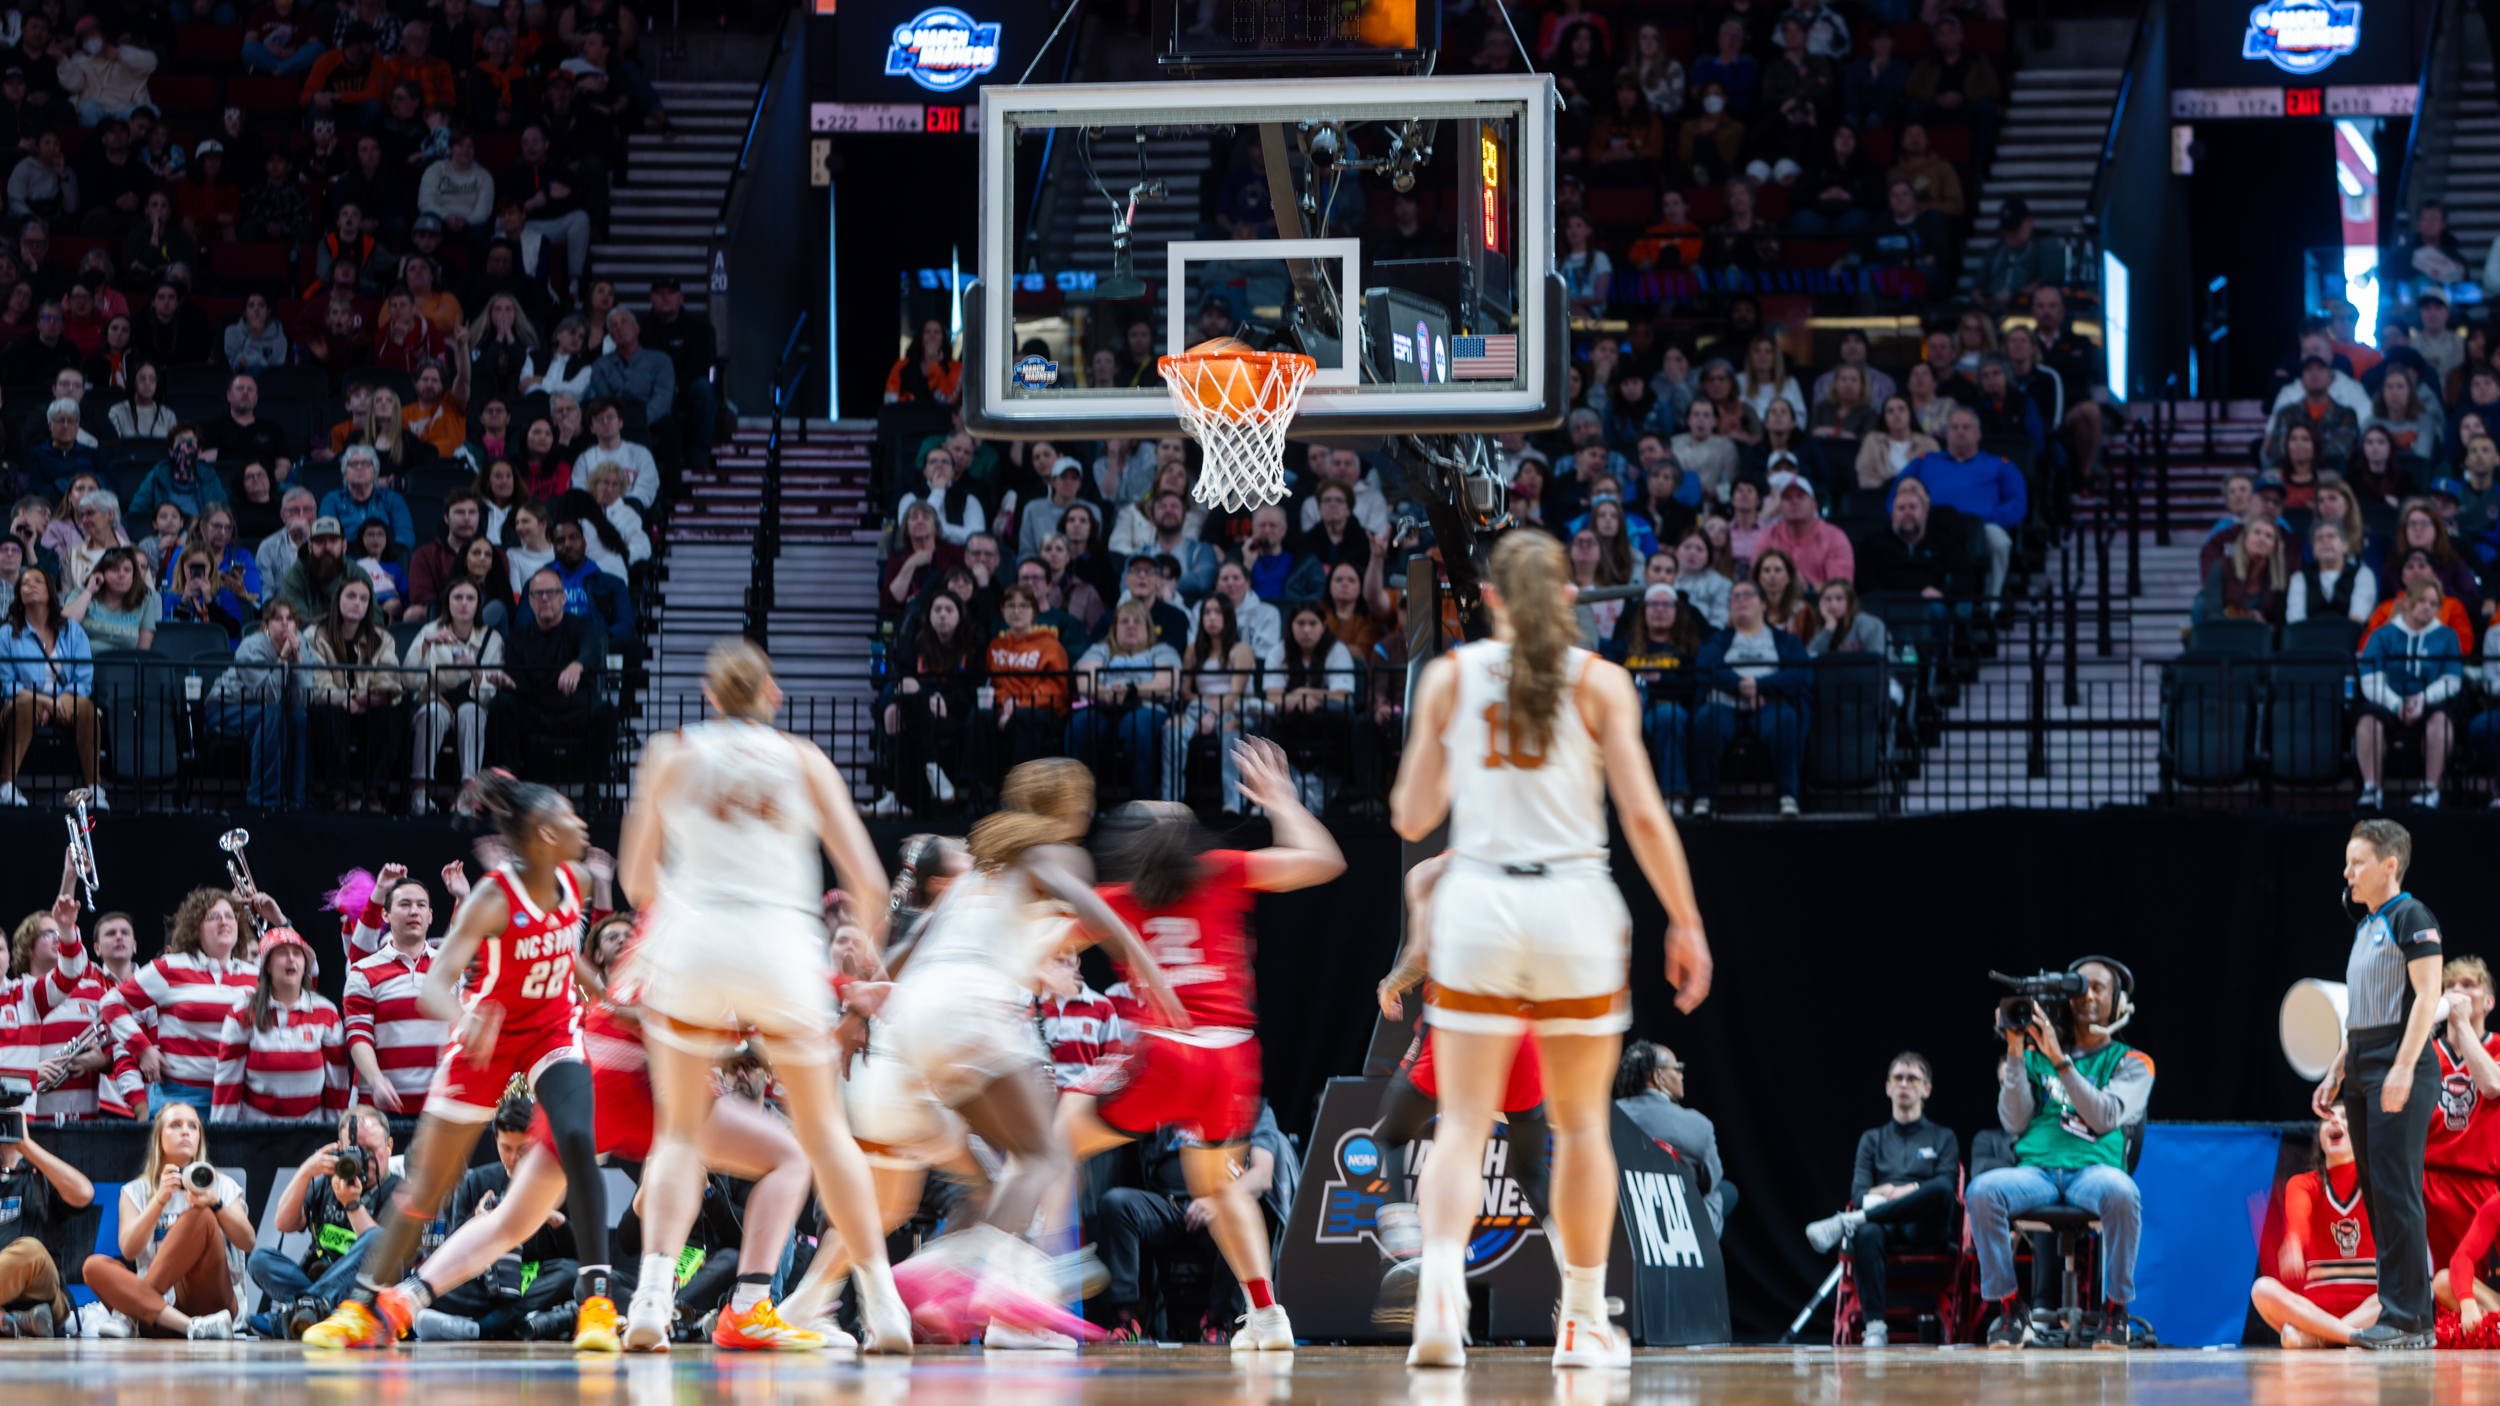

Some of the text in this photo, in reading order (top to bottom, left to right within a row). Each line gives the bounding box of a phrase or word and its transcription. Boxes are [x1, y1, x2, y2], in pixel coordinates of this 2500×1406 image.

[912, 29, 970, 48] MARCH
[919, 46, 994, 65] MADNESS
[2286, 88, 2322, 116] EXIT
[828, 115, 906, 130] 222 116
[927, 105, 962, 133] EXIT
[1393, 332, 1413, 364] ESPN
[1022, 364, 1046, 373] MARCH
[1025, 371, 1056, 381] MADNESS
[991, 648, 1041, 669] TEXAS
[514, 935, 541, 960] NC
[520, 953, 572, 999] 22
[1625, 1170, 1704, 1268] NCAA
